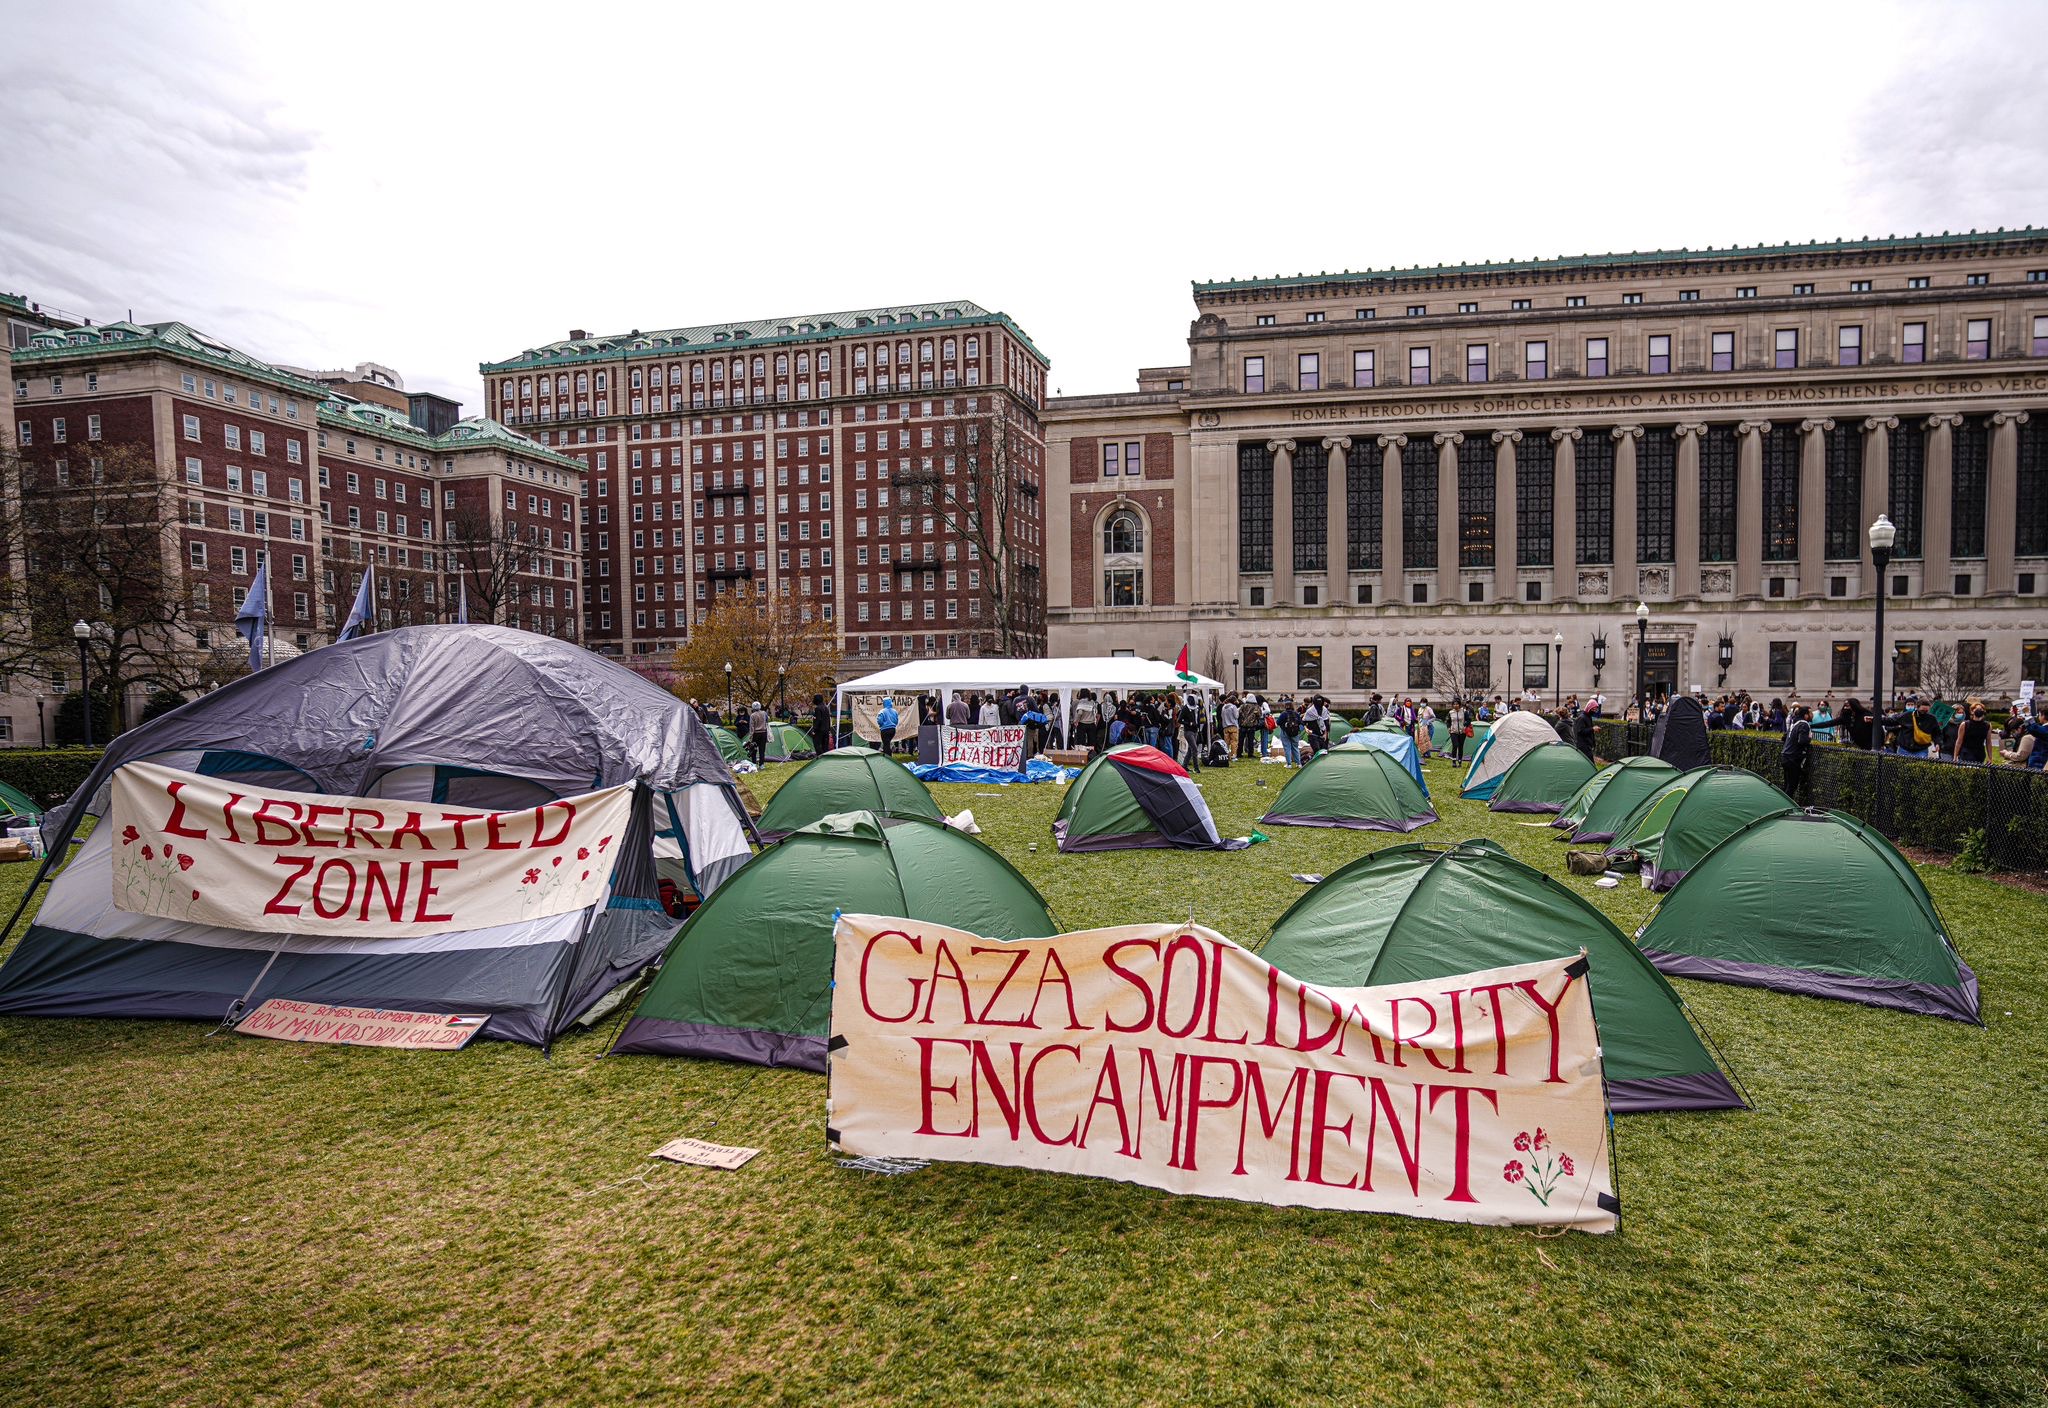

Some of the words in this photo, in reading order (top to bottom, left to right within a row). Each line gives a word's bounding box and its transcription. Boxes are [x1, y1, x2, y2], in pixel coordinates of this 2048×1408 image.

[1292, 408, 1347, 421] HOMER
[1359, 402, 1460, 418] HERODOTUS
[1473, 397, 1572, 413] SOPHOCLES
[1586, 394, 1642, 408] PLATO
[1657, 390, 1753, 406] ARISTOTLE
[1766, 384, 1899, 401] DEMOSTHENES
[1913, 380, 1983, 396] CICERO
[855, 695, 873, 706] WE
[950, 730, 981, 743] WHILE
[987, 729, 1002, 743] YOU
[1004, 729, 1024, 742] READ
[948, 746, 980, 763] GAZA
[160, 780, 577, 850] LIBERATED
[263, 853, 459, 923] ZONE
[267, 1000, 307, 1014] ISRAEL
[357, 1010, 414, 1023] COLUMBIA
[414, 1014, 445, 1025] PAYS
[860, 930, 1093, 1030] GAZA
[1102, 935, 1573, 1084] SOLIDARITY
[243, 1010, 287, 1031] HOW
[280, 1017, 338, 1037] MANY
[328, 1022, 373, 1041] KIDS
[367, 1026, 396, 1042] DID
[391, 1027, 409, 1042] U
[912, 1036, 1499, 1203] ENCAMPMENT
